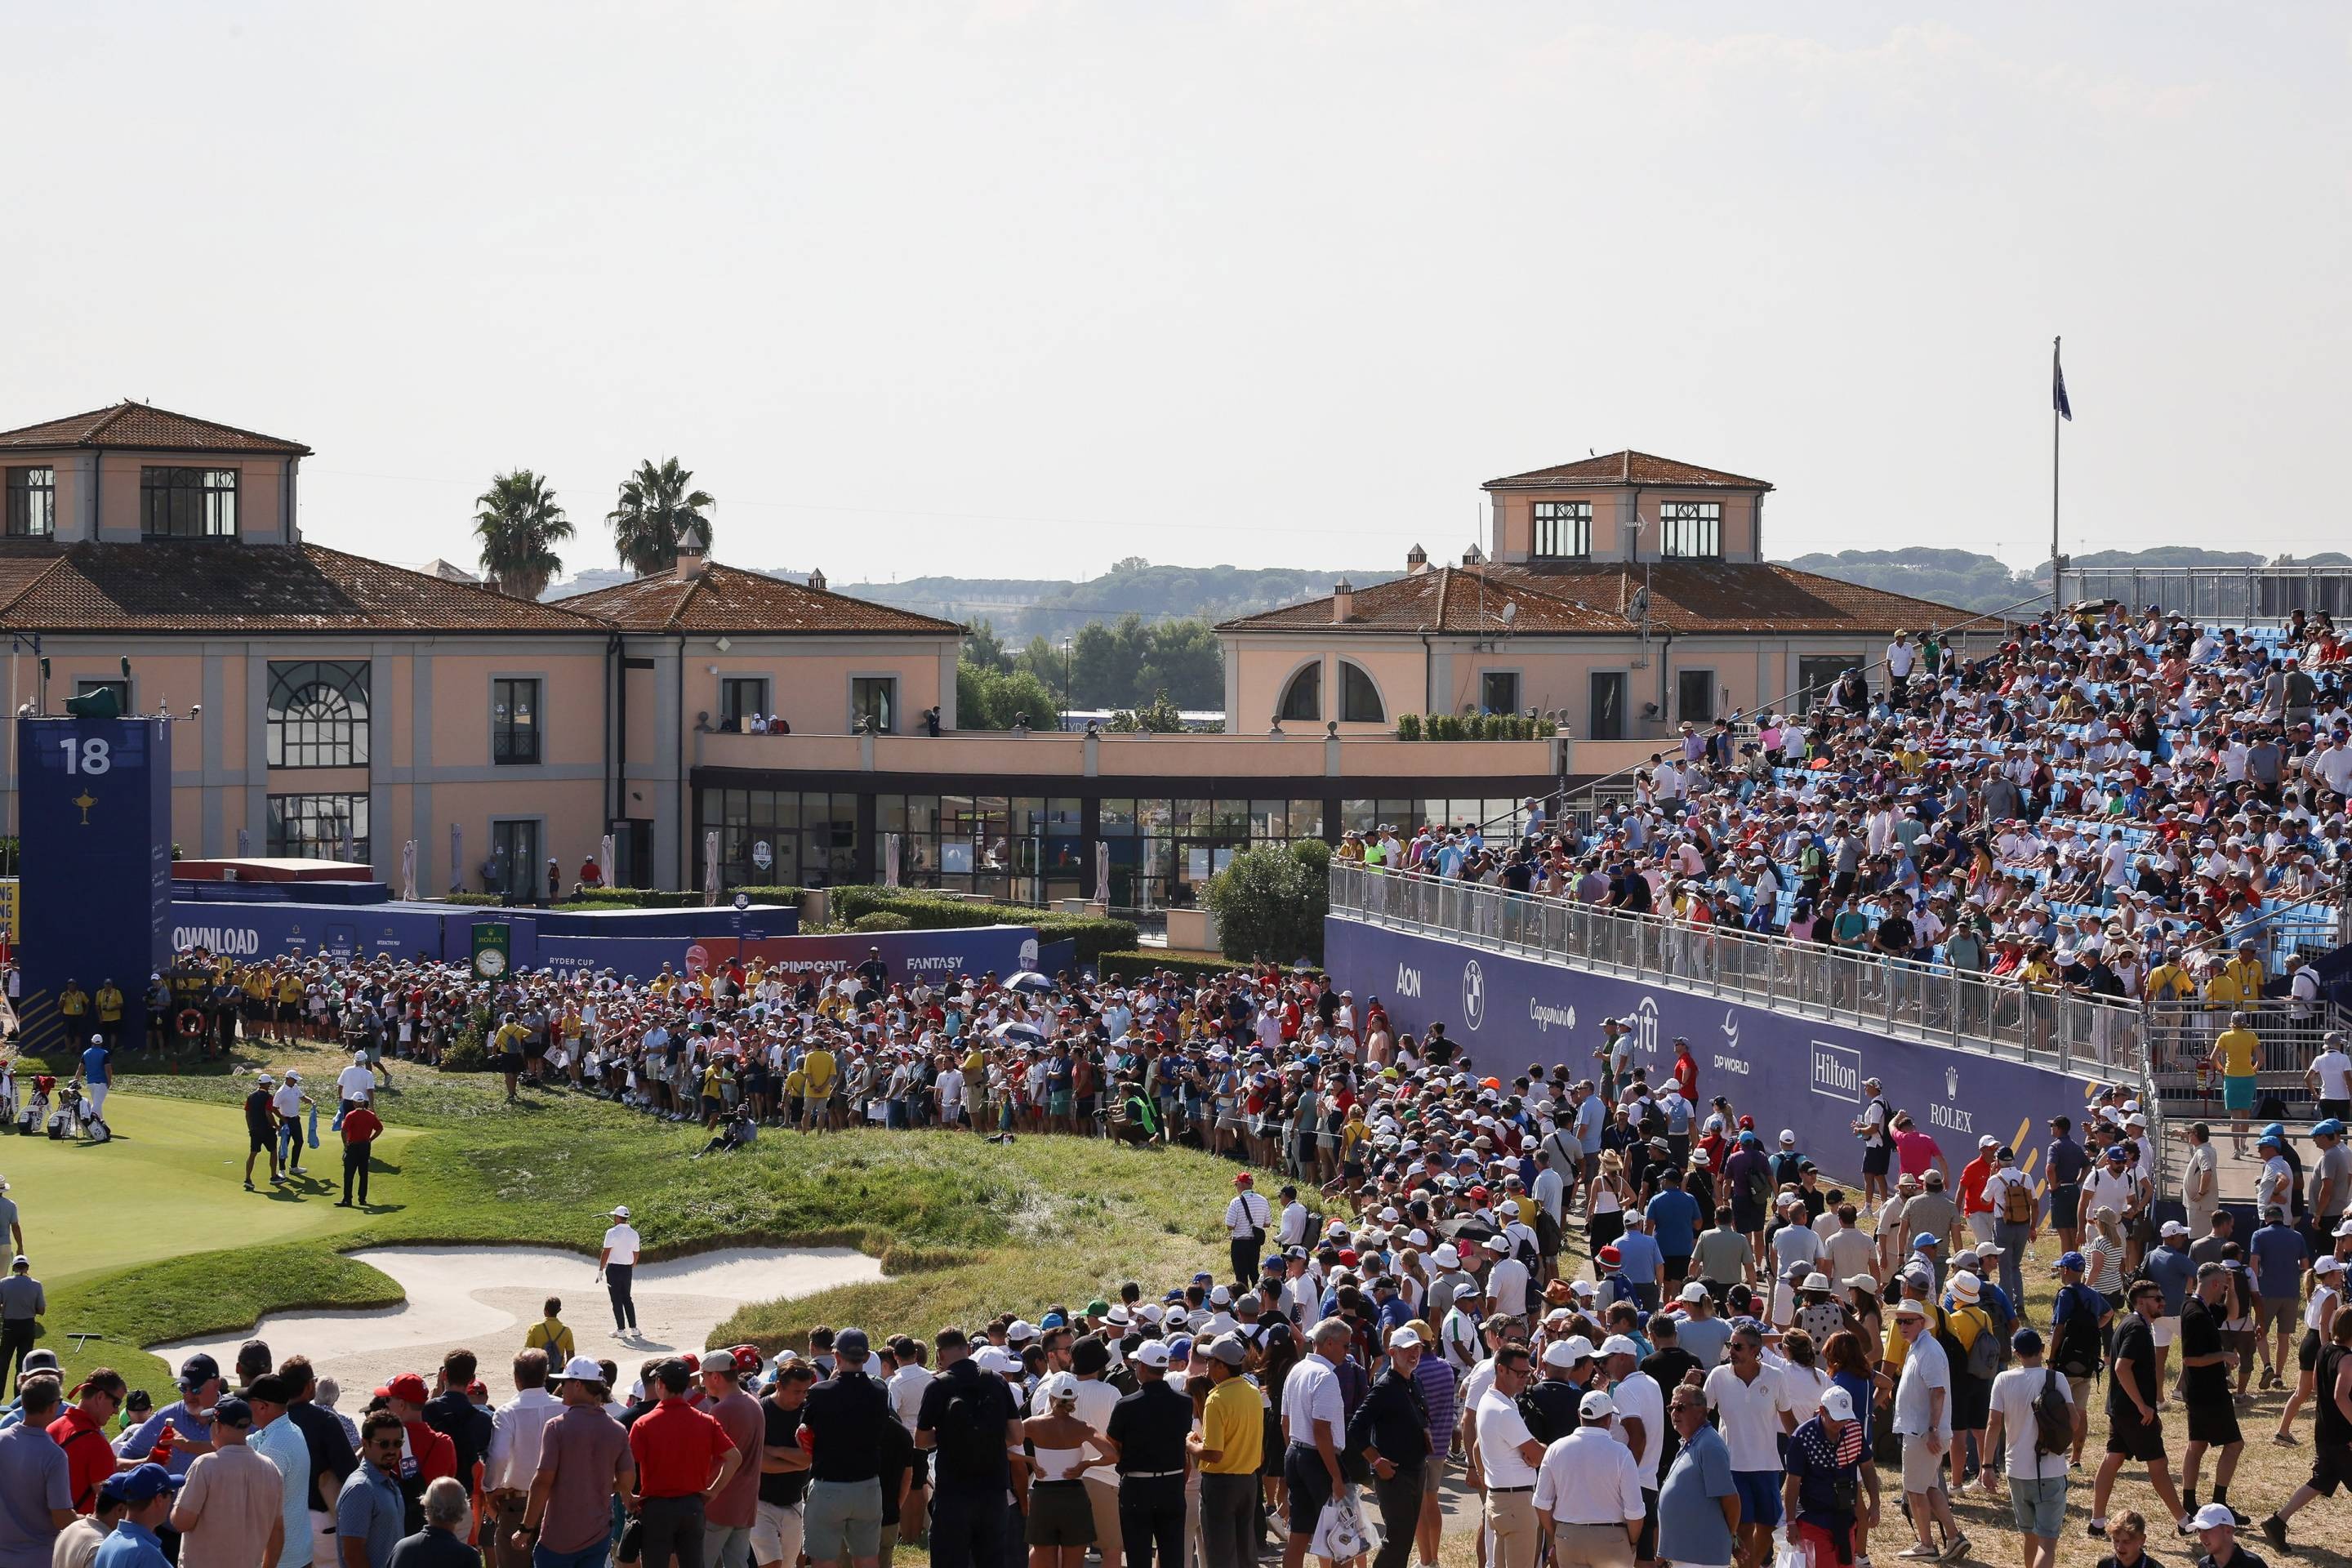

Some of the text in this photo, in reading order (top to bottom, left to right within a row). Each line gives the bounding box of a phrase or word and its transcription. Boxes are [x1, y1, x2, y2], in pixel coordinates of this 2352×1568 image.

[60, 738, 110, 775] 18
[172, 926, 259, 955] OWNLOAD
[906, 956, 964, 970] FANTASY
[1396, 962, 1421, 999] AON
[1530, 996, 1567, 1032] Capgemini
[1714, 1054, 1749, 1075] DP WORLD
[1815, 1052, 1856, 1091] Hilton
[1930, 1102, 1972, 1134] ROLEX
